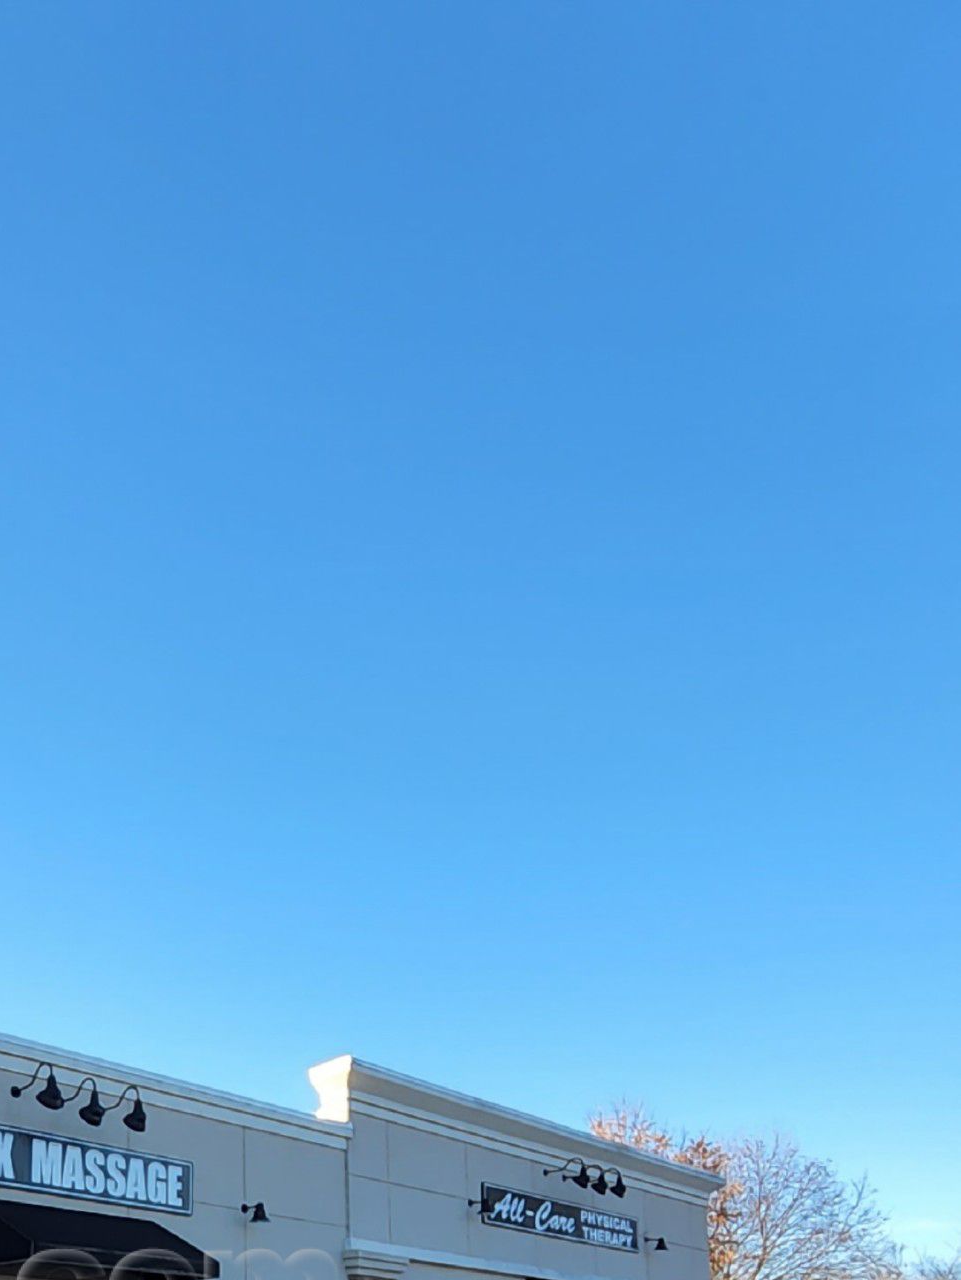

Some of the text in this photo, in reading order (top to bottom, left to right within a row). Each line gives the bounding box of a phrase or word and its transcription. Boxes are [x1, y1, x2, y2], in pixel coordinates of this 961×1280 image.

[31, 1138, 183, 1207] MASSAGE
[490, 1193, 576, 1233] All-Care
[580, 1210, 634, 1233] PHYSICAL
[582, 1227, 633, 1248] THERAPY
